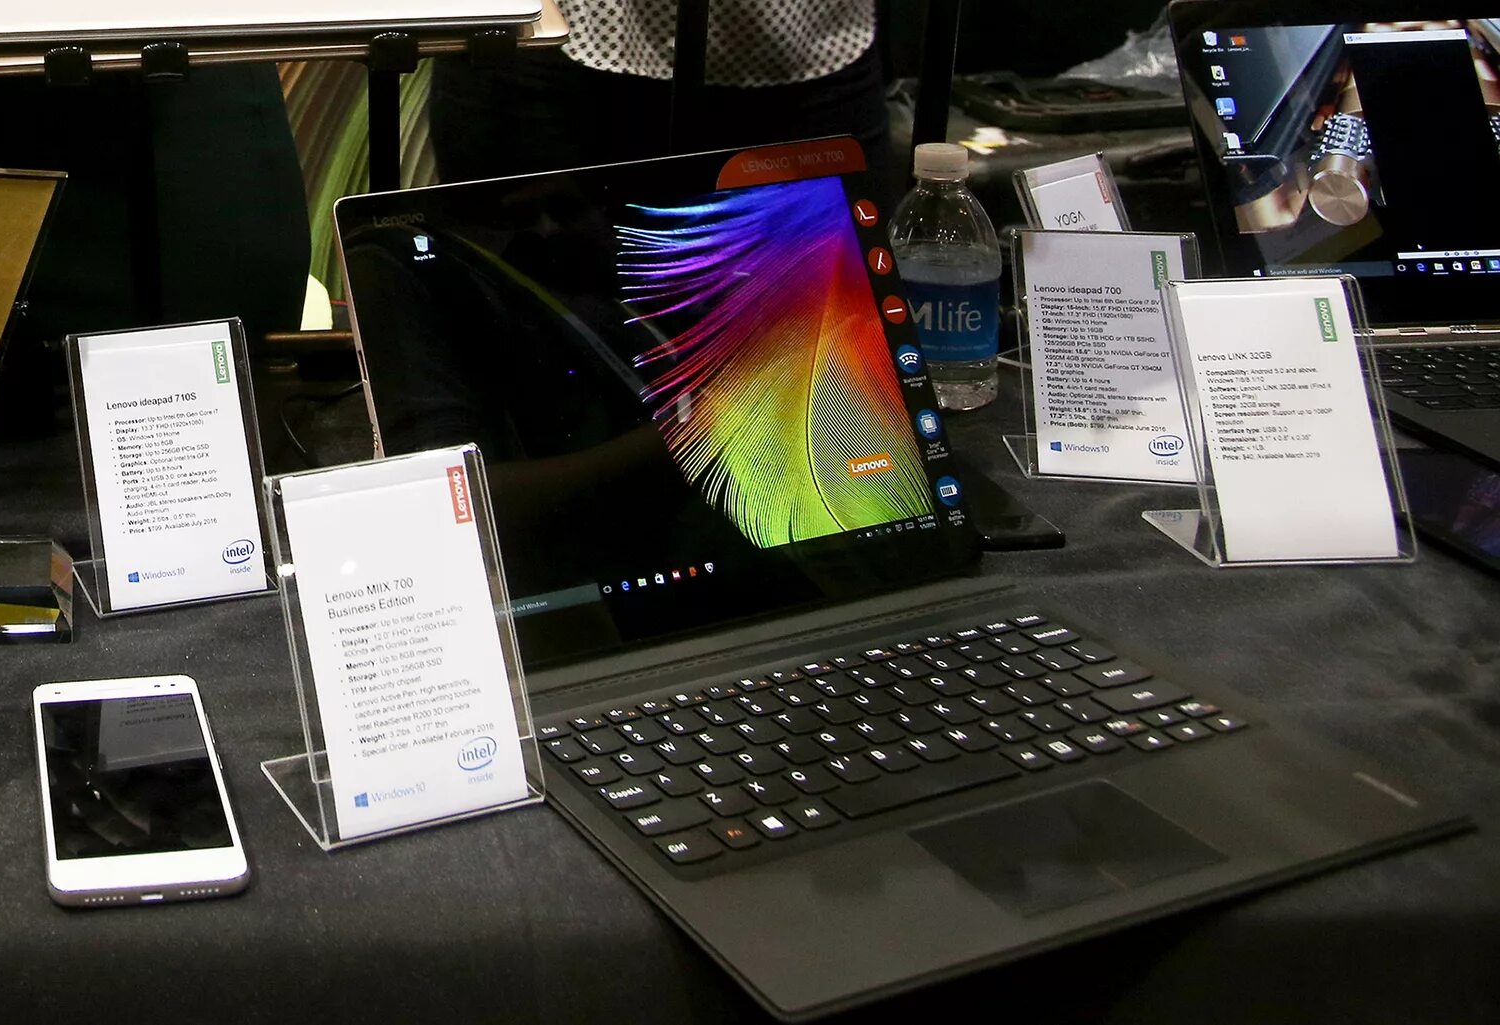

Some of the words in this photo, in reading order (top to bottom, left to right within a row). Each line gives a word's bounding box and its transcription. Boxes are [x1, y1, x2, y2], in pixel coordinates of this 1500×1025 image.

[741, 157, 790, 173] LENOVO
[1034, 285, 1066, 294] Lenovo
[1068, 286, 1102, 295] ideapad
[1105, 287, 1122, 295] 700
[1319, 301, 1334, 339] Lenovo
[216, 343, 226, 381] Lenovo
[1197, 354, 1226, 362] Lenovo
[1228, 353, 1248, 361] LINK
[1249, 351, 1272, 360] 32GB
[106, 400, 138, 411] Lenovo
[140, 396, 173, 407] ideapad
[174, 392, 197, 403] 710S
[1065, 443, 1100, 453] Windows
[852, 458, 888, 473] Lenovo
[1156, 458, 1178, 466] inside
[453, 470, 467, 521] Lenovo
[226, 545, 250, 557] intel
[141, 569, 176, 580] Windows
[230, 565, 251, 574] inside
[325, 589, 364, 603] Lenovo
[366, 582, 391, 595] MIIX
[393, 577, 414, 589] 700
[328, 602, 376, 619] Business
[378, 595, 415, 610] Edition
[462, 744, 491, 762] intel
[659, 742, 676, 753] W
[582, 766, 600, 778] Tab
[371, 787, 415, 803] Windows
